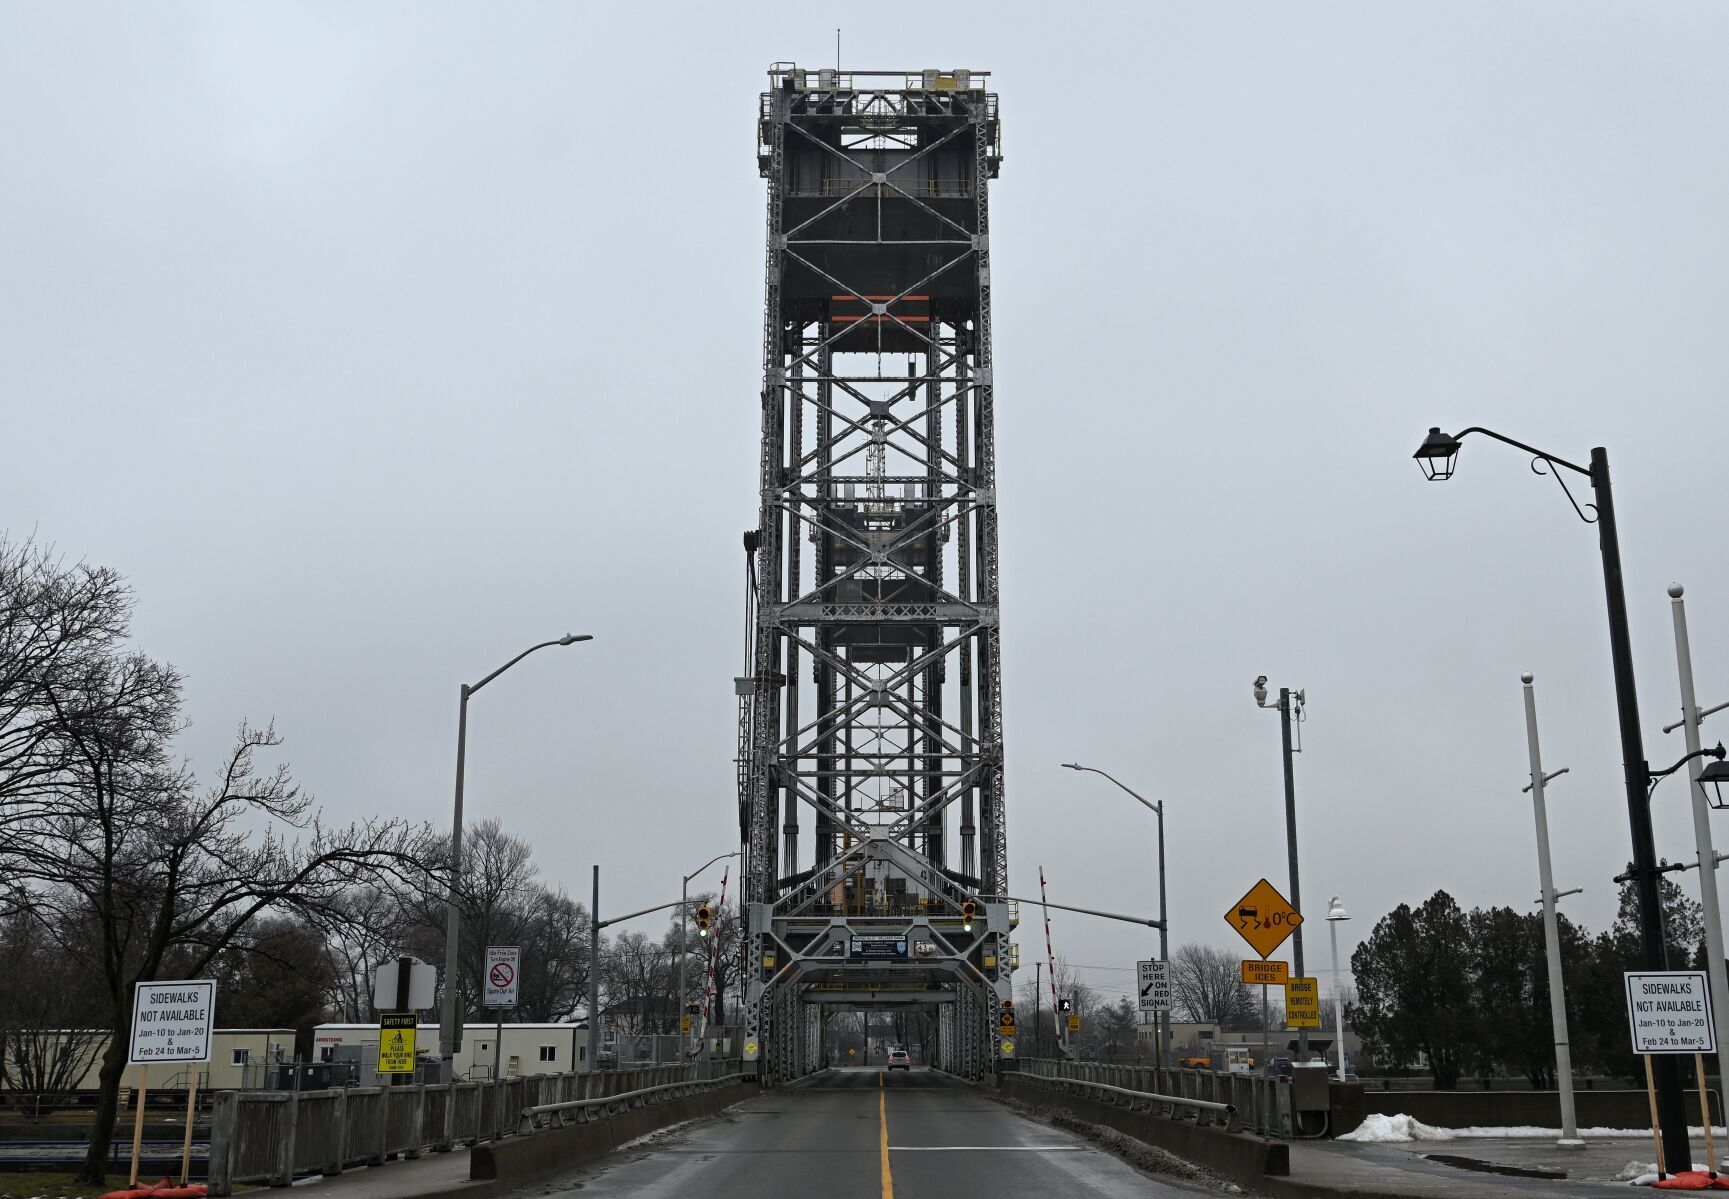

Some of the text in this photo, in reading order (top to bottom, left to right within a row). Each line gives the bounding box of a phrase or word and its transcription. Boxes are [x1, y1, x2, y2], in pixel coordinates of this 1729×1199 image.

[1142, 964, 1164, 972] STOP
[1248, 964, 1282, 973] BRIDGE
[1255, 973, 1276, 982] ICES
[1155, 981, 1167, 989] ON
[1290, 983, 1312, 992] BRIDGE
[1642, 983, 1692, 995] SIDEWALKS
[150, 991, 199, 1004] SIDEWALKS
[1154, 990, 1170, 998] RED
[1141, 999, 1169, 1007] SIGNAL
[1290, 997, 1313, 1006] REMOTELY
[1656, 1000, 1702, 1012] AVAILABLE
[140, 1009, 205, 1022] NOT AVAILABLE
[1288, 1010, 1317, 1020] CONTROLLED
[383, 1018, 400, 1026] SAFETY
[1638, 1019, 1704, 1027] Jan-10 to Jan-20
[138, 1029, 166, 1037] Jan-10
[177, 1027, 204, 1036] Jan-20
[1669, 1028, 1675, 1036] &
[1642, 1037, 1704, 1045] Feb 24 to Mar-5
[138, 1047, 153, 1055] Feb
[155, 1047, 165, 1055] 24
[176, 1046, 200, 1054] Mar-5
